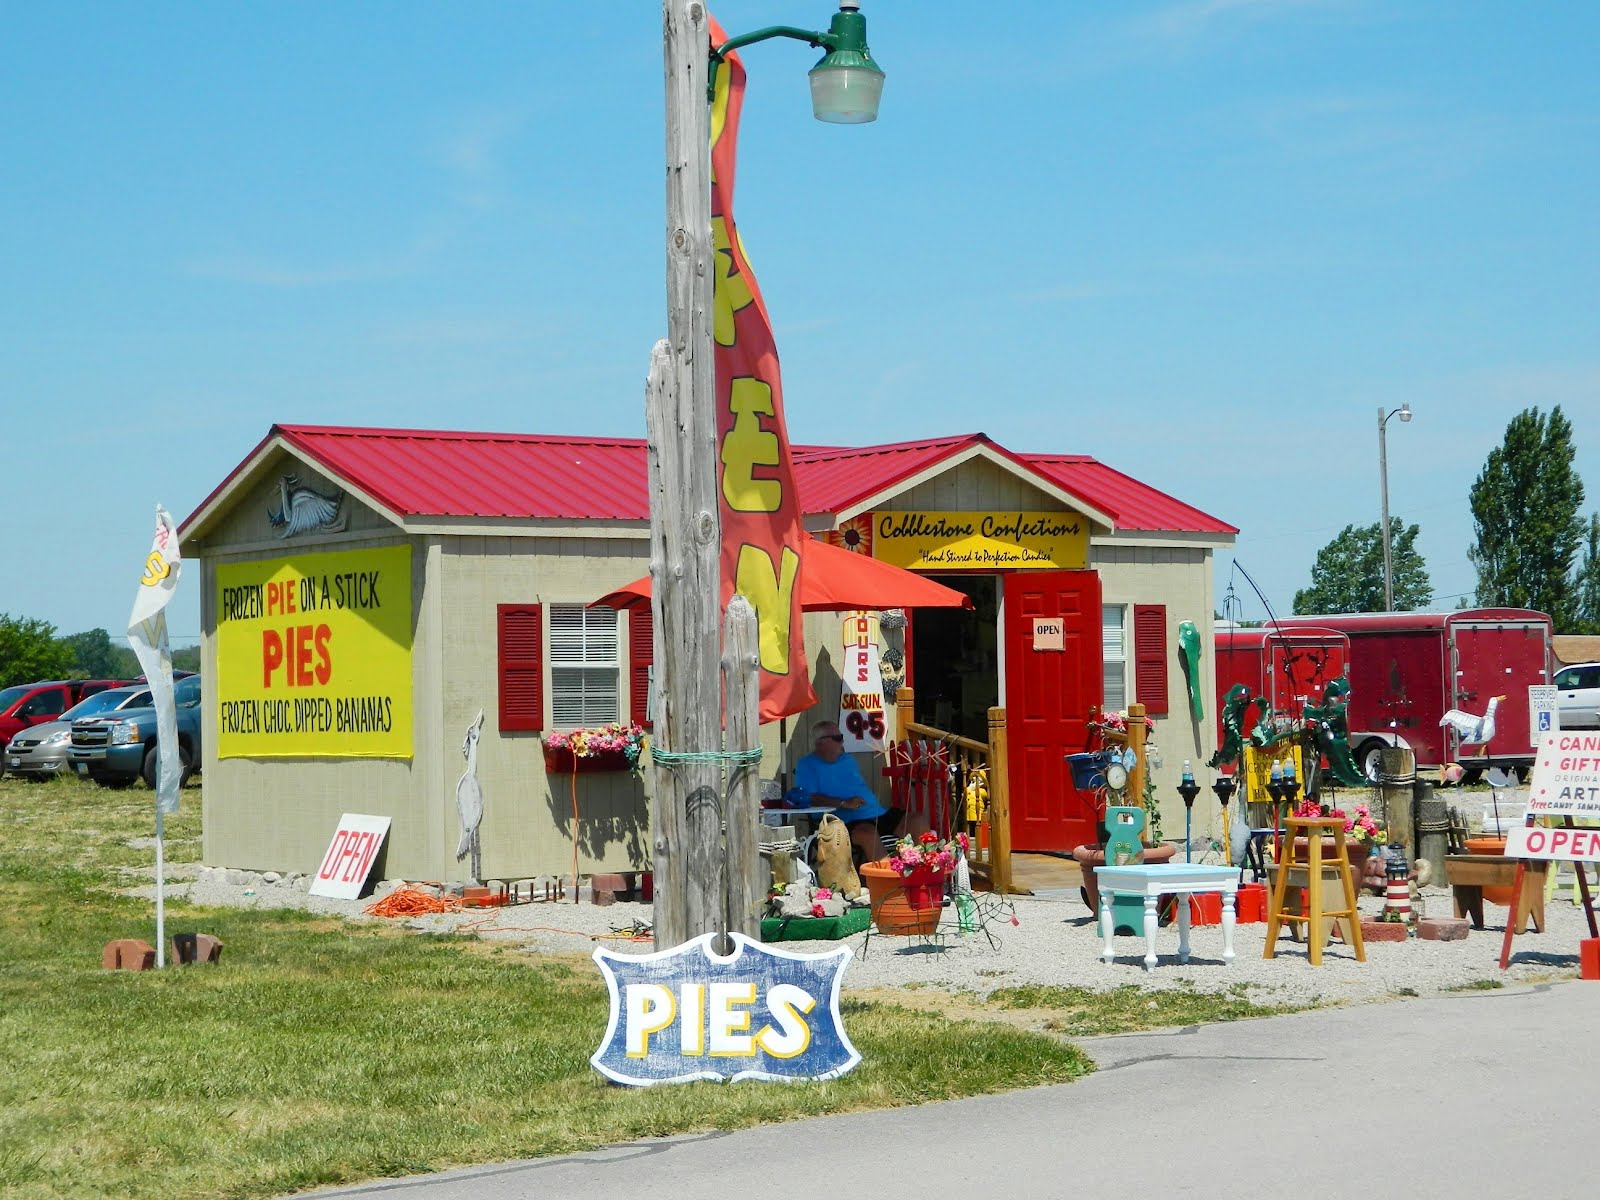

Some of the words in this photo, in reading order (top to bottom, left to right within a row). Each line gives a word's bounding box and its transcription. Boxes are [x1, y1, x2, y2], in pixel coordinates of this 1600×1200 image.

[880, 514, 974, 539] Cobblestone
[981, 513, 1080, 542] Confections
[946, 550, 973, 563] Stirred
[975, 550, 983, 562] to
[984, 549, 1020, 566] Perfection
[223, 584, 263, 621] FROZEN
[267, 580, 296, 616] PIE
[300, 576, 316, 612] ON
[320, 575, 331, 610] A
[335, 571, 380, 609] STICK
[1037, 625, 1060, 635] OPEN
[857, 611, 869, 682] OURS
[263, 624, 332, 688] PIES
[1531, 689, 1556, 699] RESERVED
[1534, 700, 1555, 710] PARKING
[221, 700, 260, 734] FROZEN
[263, 699, 293, 734] CHOC.
[295, 698, 332, 733] DIPPED
[336, 696, 392, 733] BANANAS
[1560, 737, 1600, 751] CAN
[1560, 758, 1600, 771] GIFT
[1555, 775, 1598, 783] ORIGINA
[1560, 787, 1600, 800] ART
[1531, 798, 1548, 809] Free
[1526, 831, 1600, 856] OPEN
[320, 830, 381, 883] OPEN
[625, 983, 816, 1059] PIES
